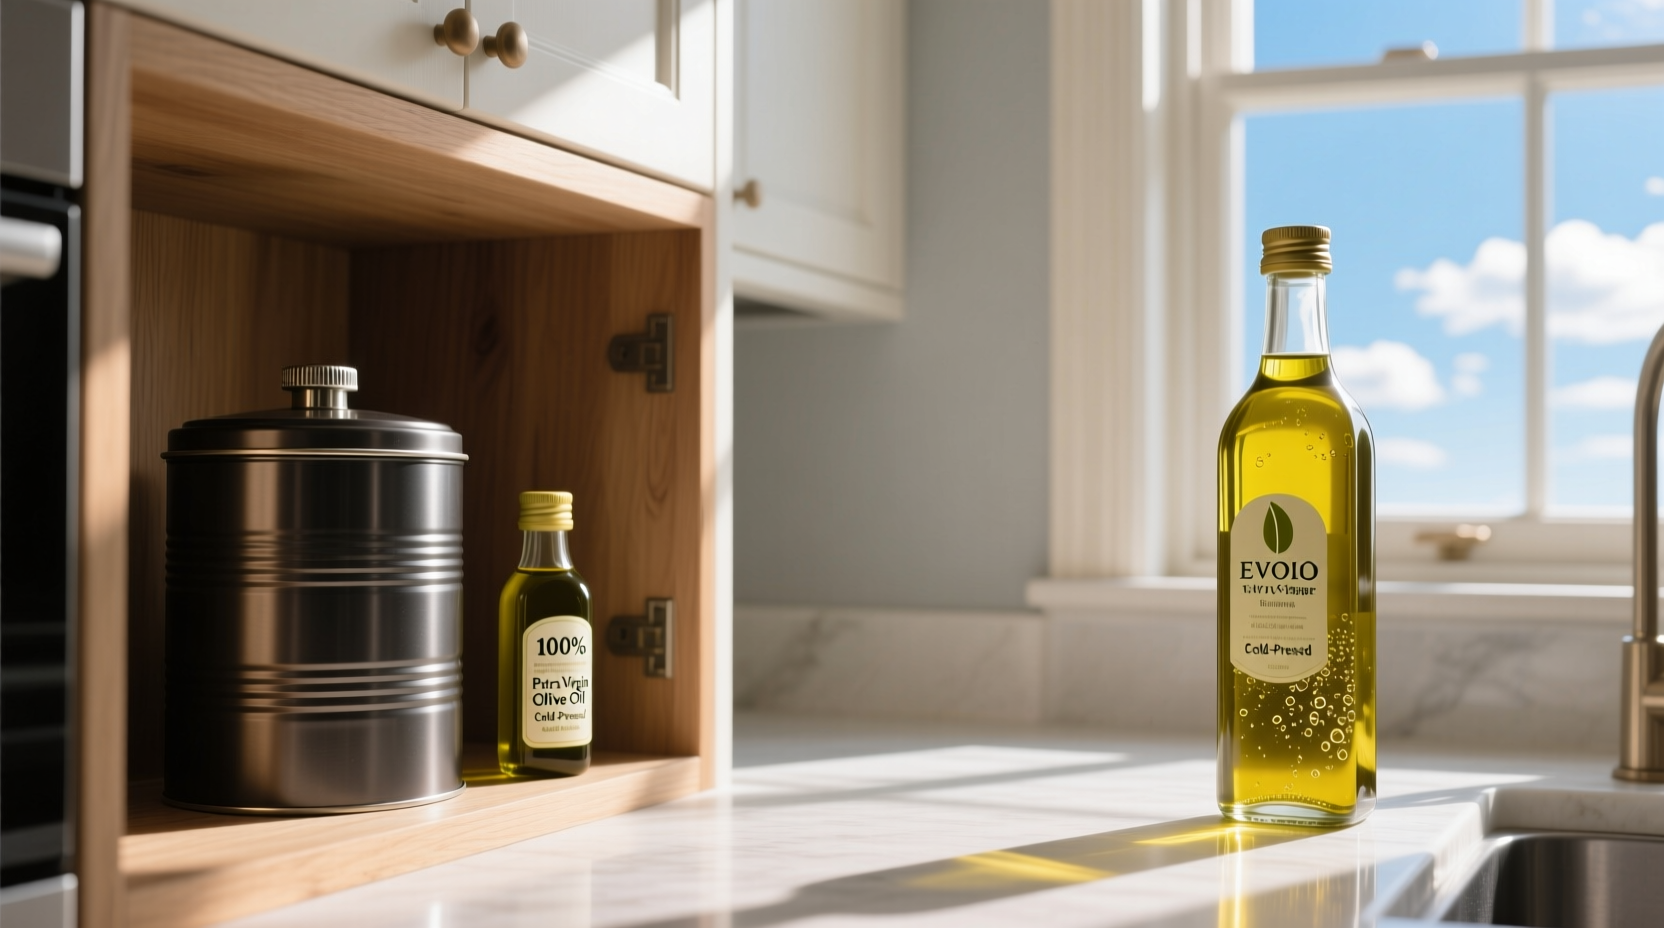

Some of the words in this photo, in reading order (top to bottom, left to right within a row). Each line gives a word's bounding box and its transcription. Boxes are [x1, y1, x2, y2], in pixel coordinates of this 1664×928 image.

[1239, 561, 1318, 580] EVOIO
[537, 636, 586, 656] 100%
[533, 692, 566, 706] Olive
[570, 691, 585, 705] Oil
